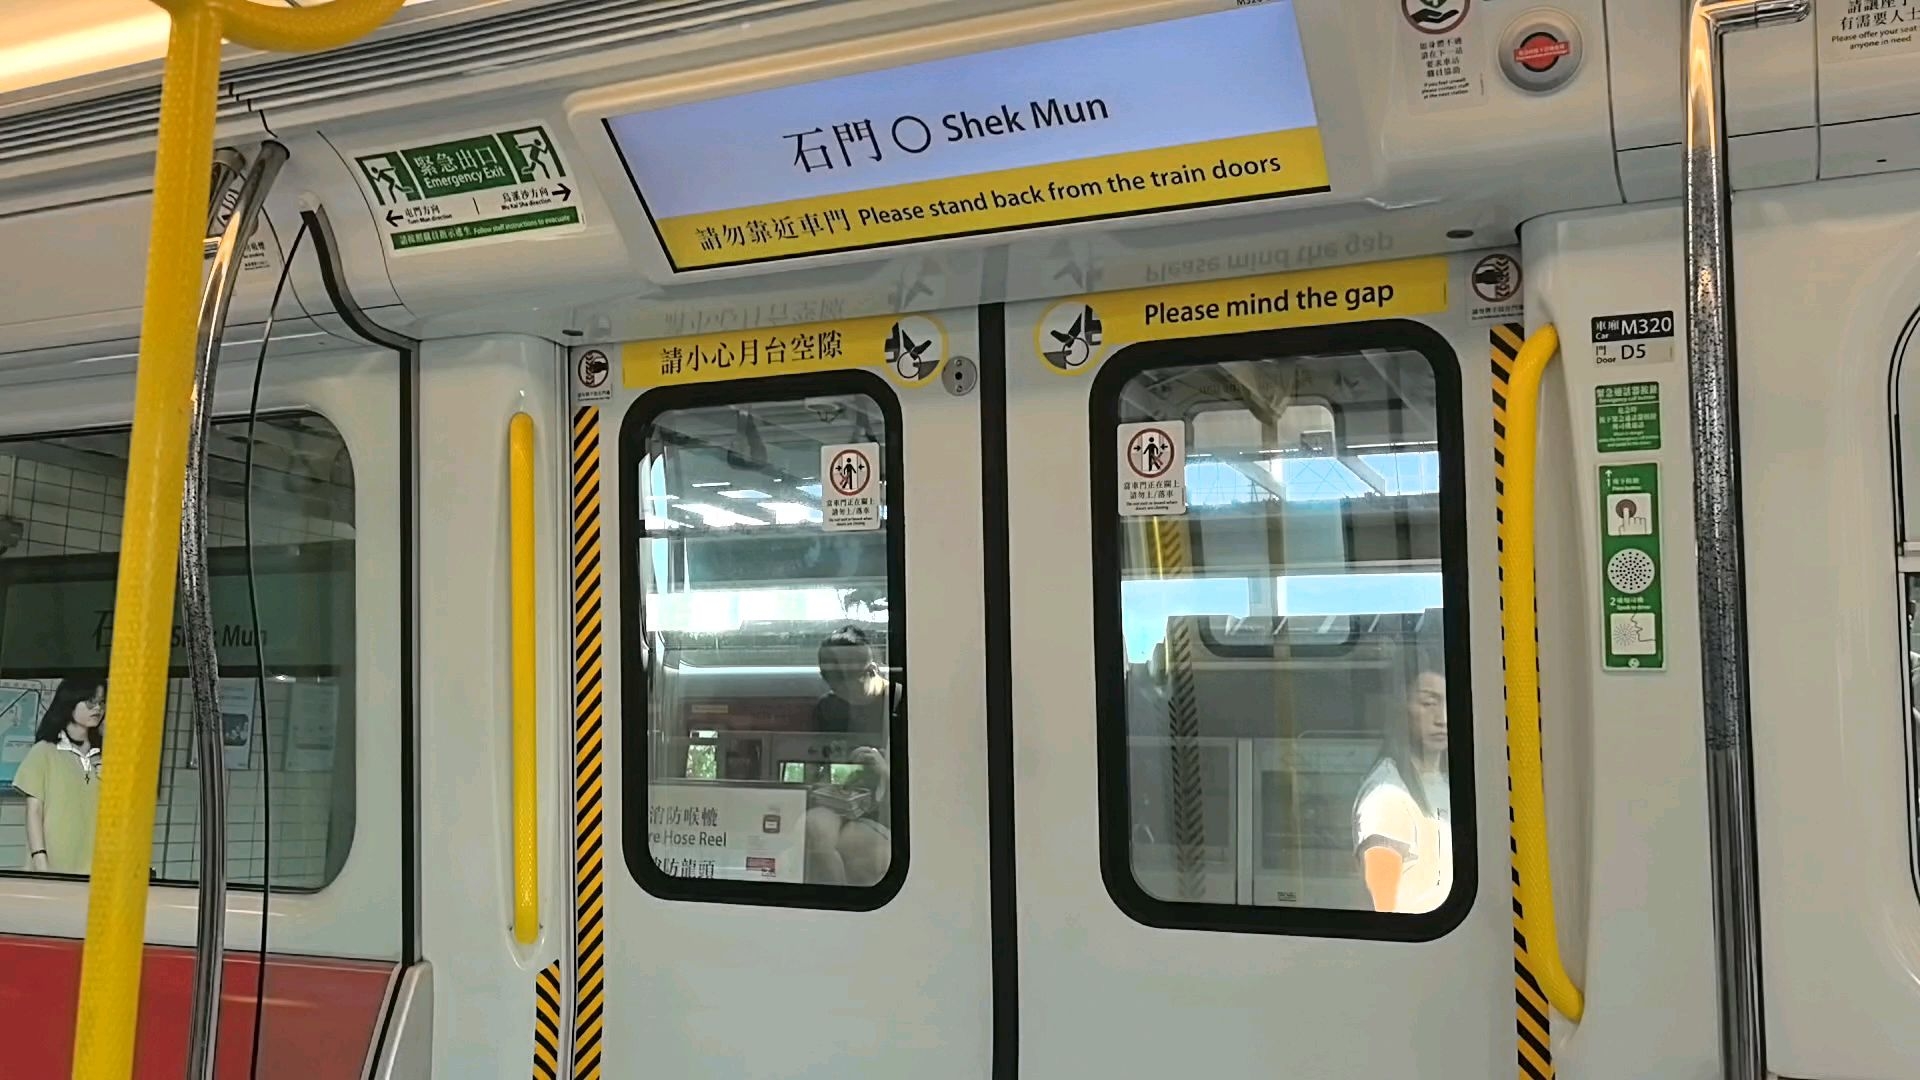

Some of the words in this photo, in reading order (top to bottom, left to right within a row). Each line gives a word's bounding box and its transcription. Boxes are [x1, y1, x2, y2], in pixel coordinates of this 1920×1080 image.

[1842, 6, 1920, 30] 有需要人士
[1859, 30, 1878, 39] offer
[1880, 28, 1898, 38] your
[783, 118, 882, 173] 石門
[942, 105, 1026, 142] Shek
[1030, 98, 1108, 128] Mun
[414, 147, 497, 176] 緊急出口
[424, 172, 483, 188] Emergency
[483, 166, 506, 179] Exit
[502, 187, 549, 203] 烏溪沙方向
[696, 208, 851, 251] 請勿靠近車門
[858, 207, 925, 226] Please
[929, 192, 987, 217] stand
[991, 185, 1045, 208] back
[1048, 179, 1102, 201] from
[1107, 174, 1145, 193] the
[1151, 165, 1206, 187] train
[1212, 157, 1281, 179] doors
[405, 204, 440, 217] 屯門方向
[1146, 302, 1220, 325] Please
[1227, 289, 1288, 317] mind
[1296, 287, 1337, 310] the
[1345, 284, 1394, 311] gap
[1596, 320, 1620, 331] 車廂
[1621, 317, 1672, 336] M320
[662, 330, 843, 376] 請小心月台空隙
[1596, 345, 1606, 355] 門
[1621, 344, 1646, 360] D5
[1607, 479, 1610, 487] 1
[1610, 597, 1616, 606] 2
[664, 830, 695, 845] Hose
[700, 832, 727, 846] Reel
